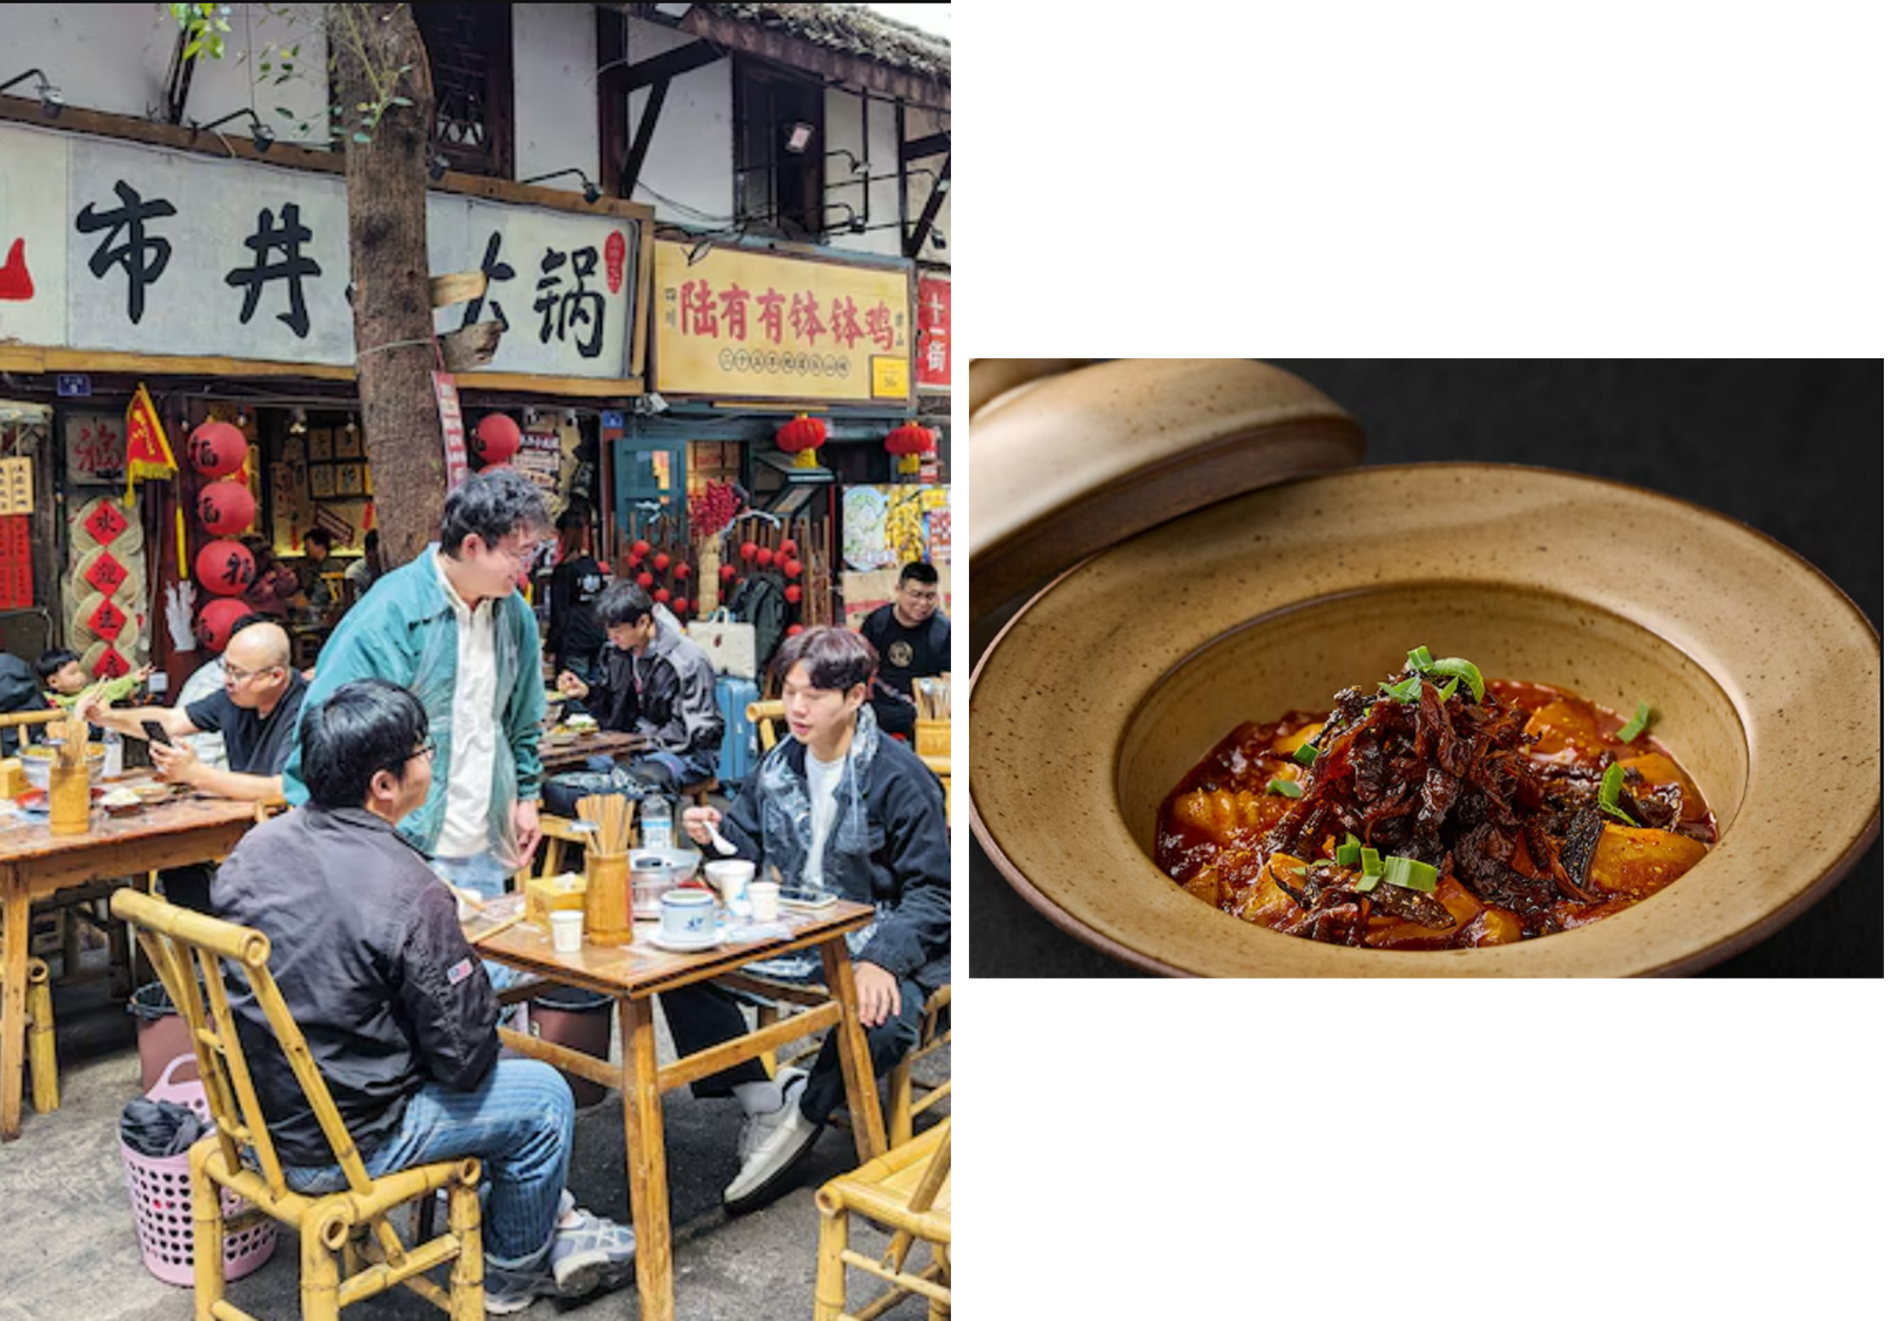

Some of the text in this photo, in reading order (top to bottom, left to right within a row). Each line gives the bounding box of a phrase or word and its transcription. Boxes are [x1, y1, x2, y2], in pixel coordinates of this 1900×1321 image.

[75, 179, 605, 359] 市井火锅
[681, 279, 893, 351] 陆有有钵钵鸡
[928, 293, 946, 373] 十一街
